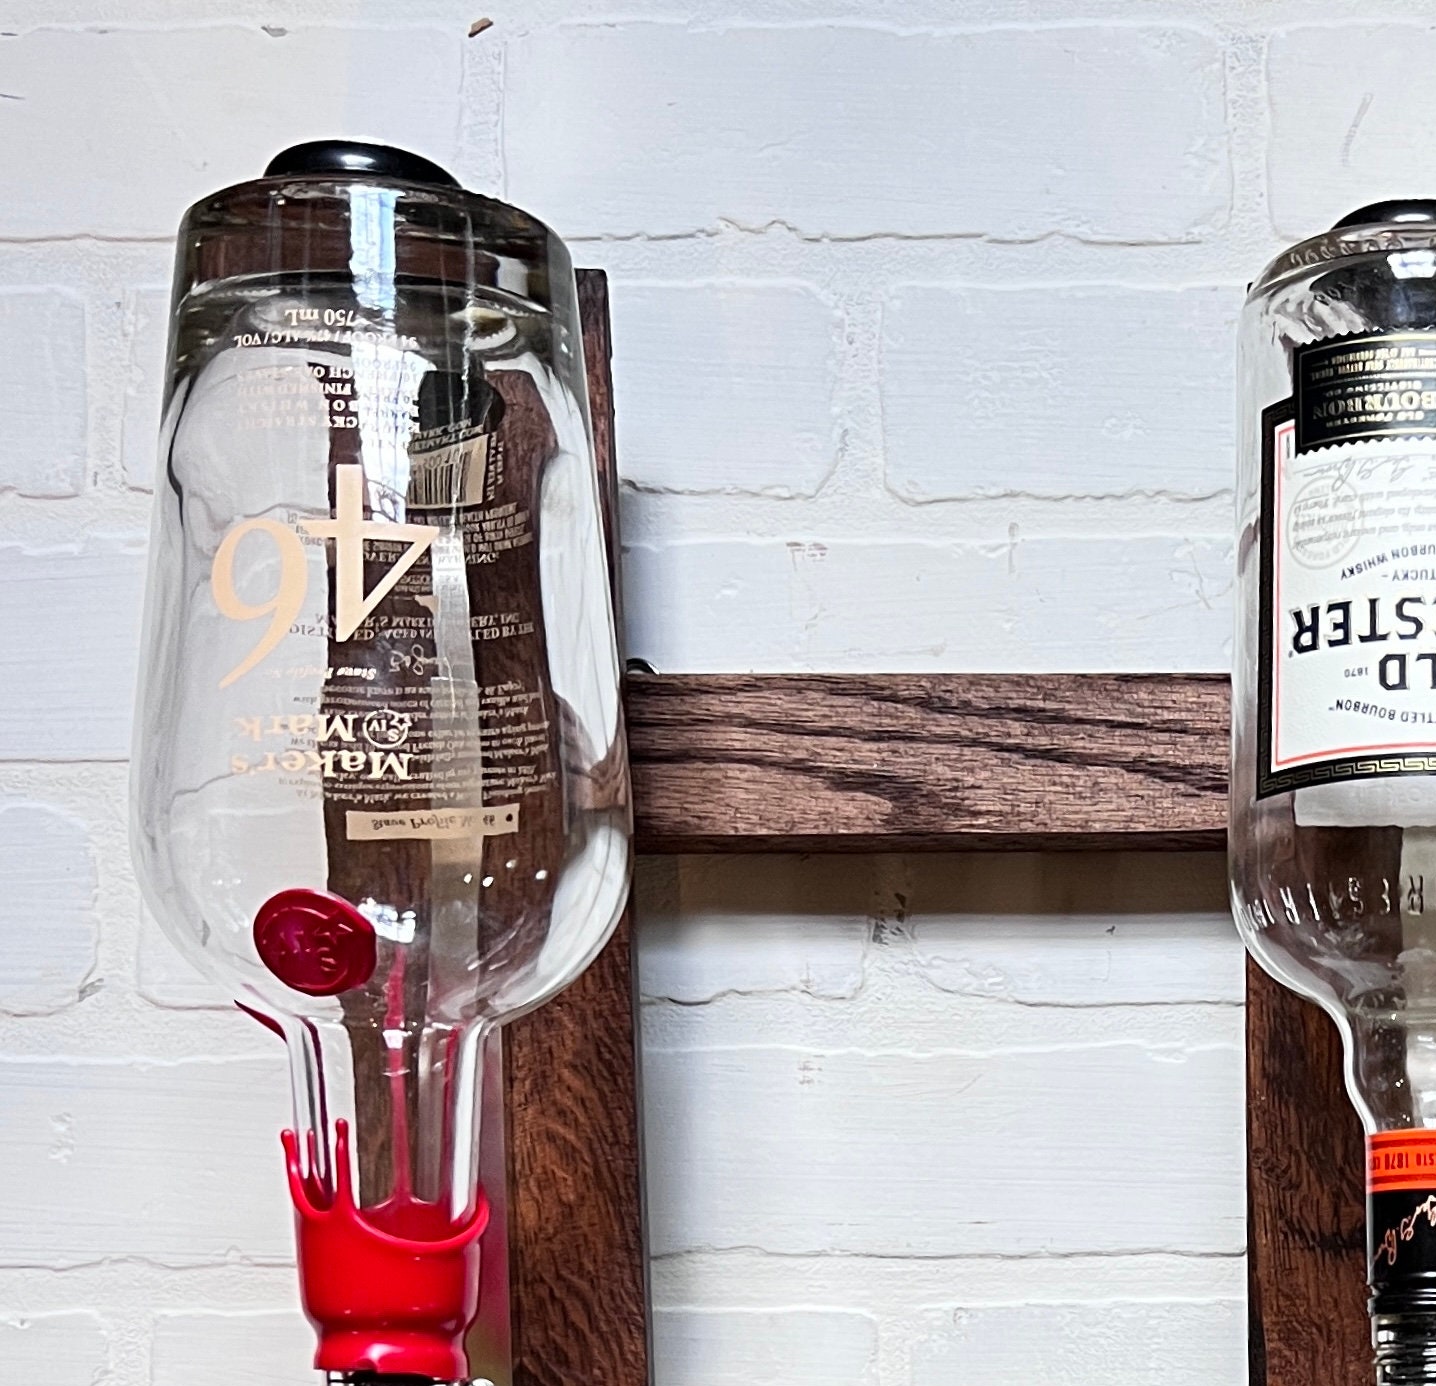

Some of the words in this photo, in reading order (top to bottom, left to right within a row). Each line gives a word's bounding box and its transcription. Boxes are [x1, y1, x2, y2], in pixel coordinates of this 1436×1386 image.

[284, 308, 320, 326] mL
[323, 309, 354, 326] 750
[1339, 552, 1389, 581] WHISKY
[210, 463, 440, 690] 46
[336, 667, 377, 681] Stave
[1343, 666, 1369, 678] 1870
[231, 713, 357, 743] Mark
[229, 749, 414, 781] Maker's
[1384, 1152, 1409, 1171] 1870
